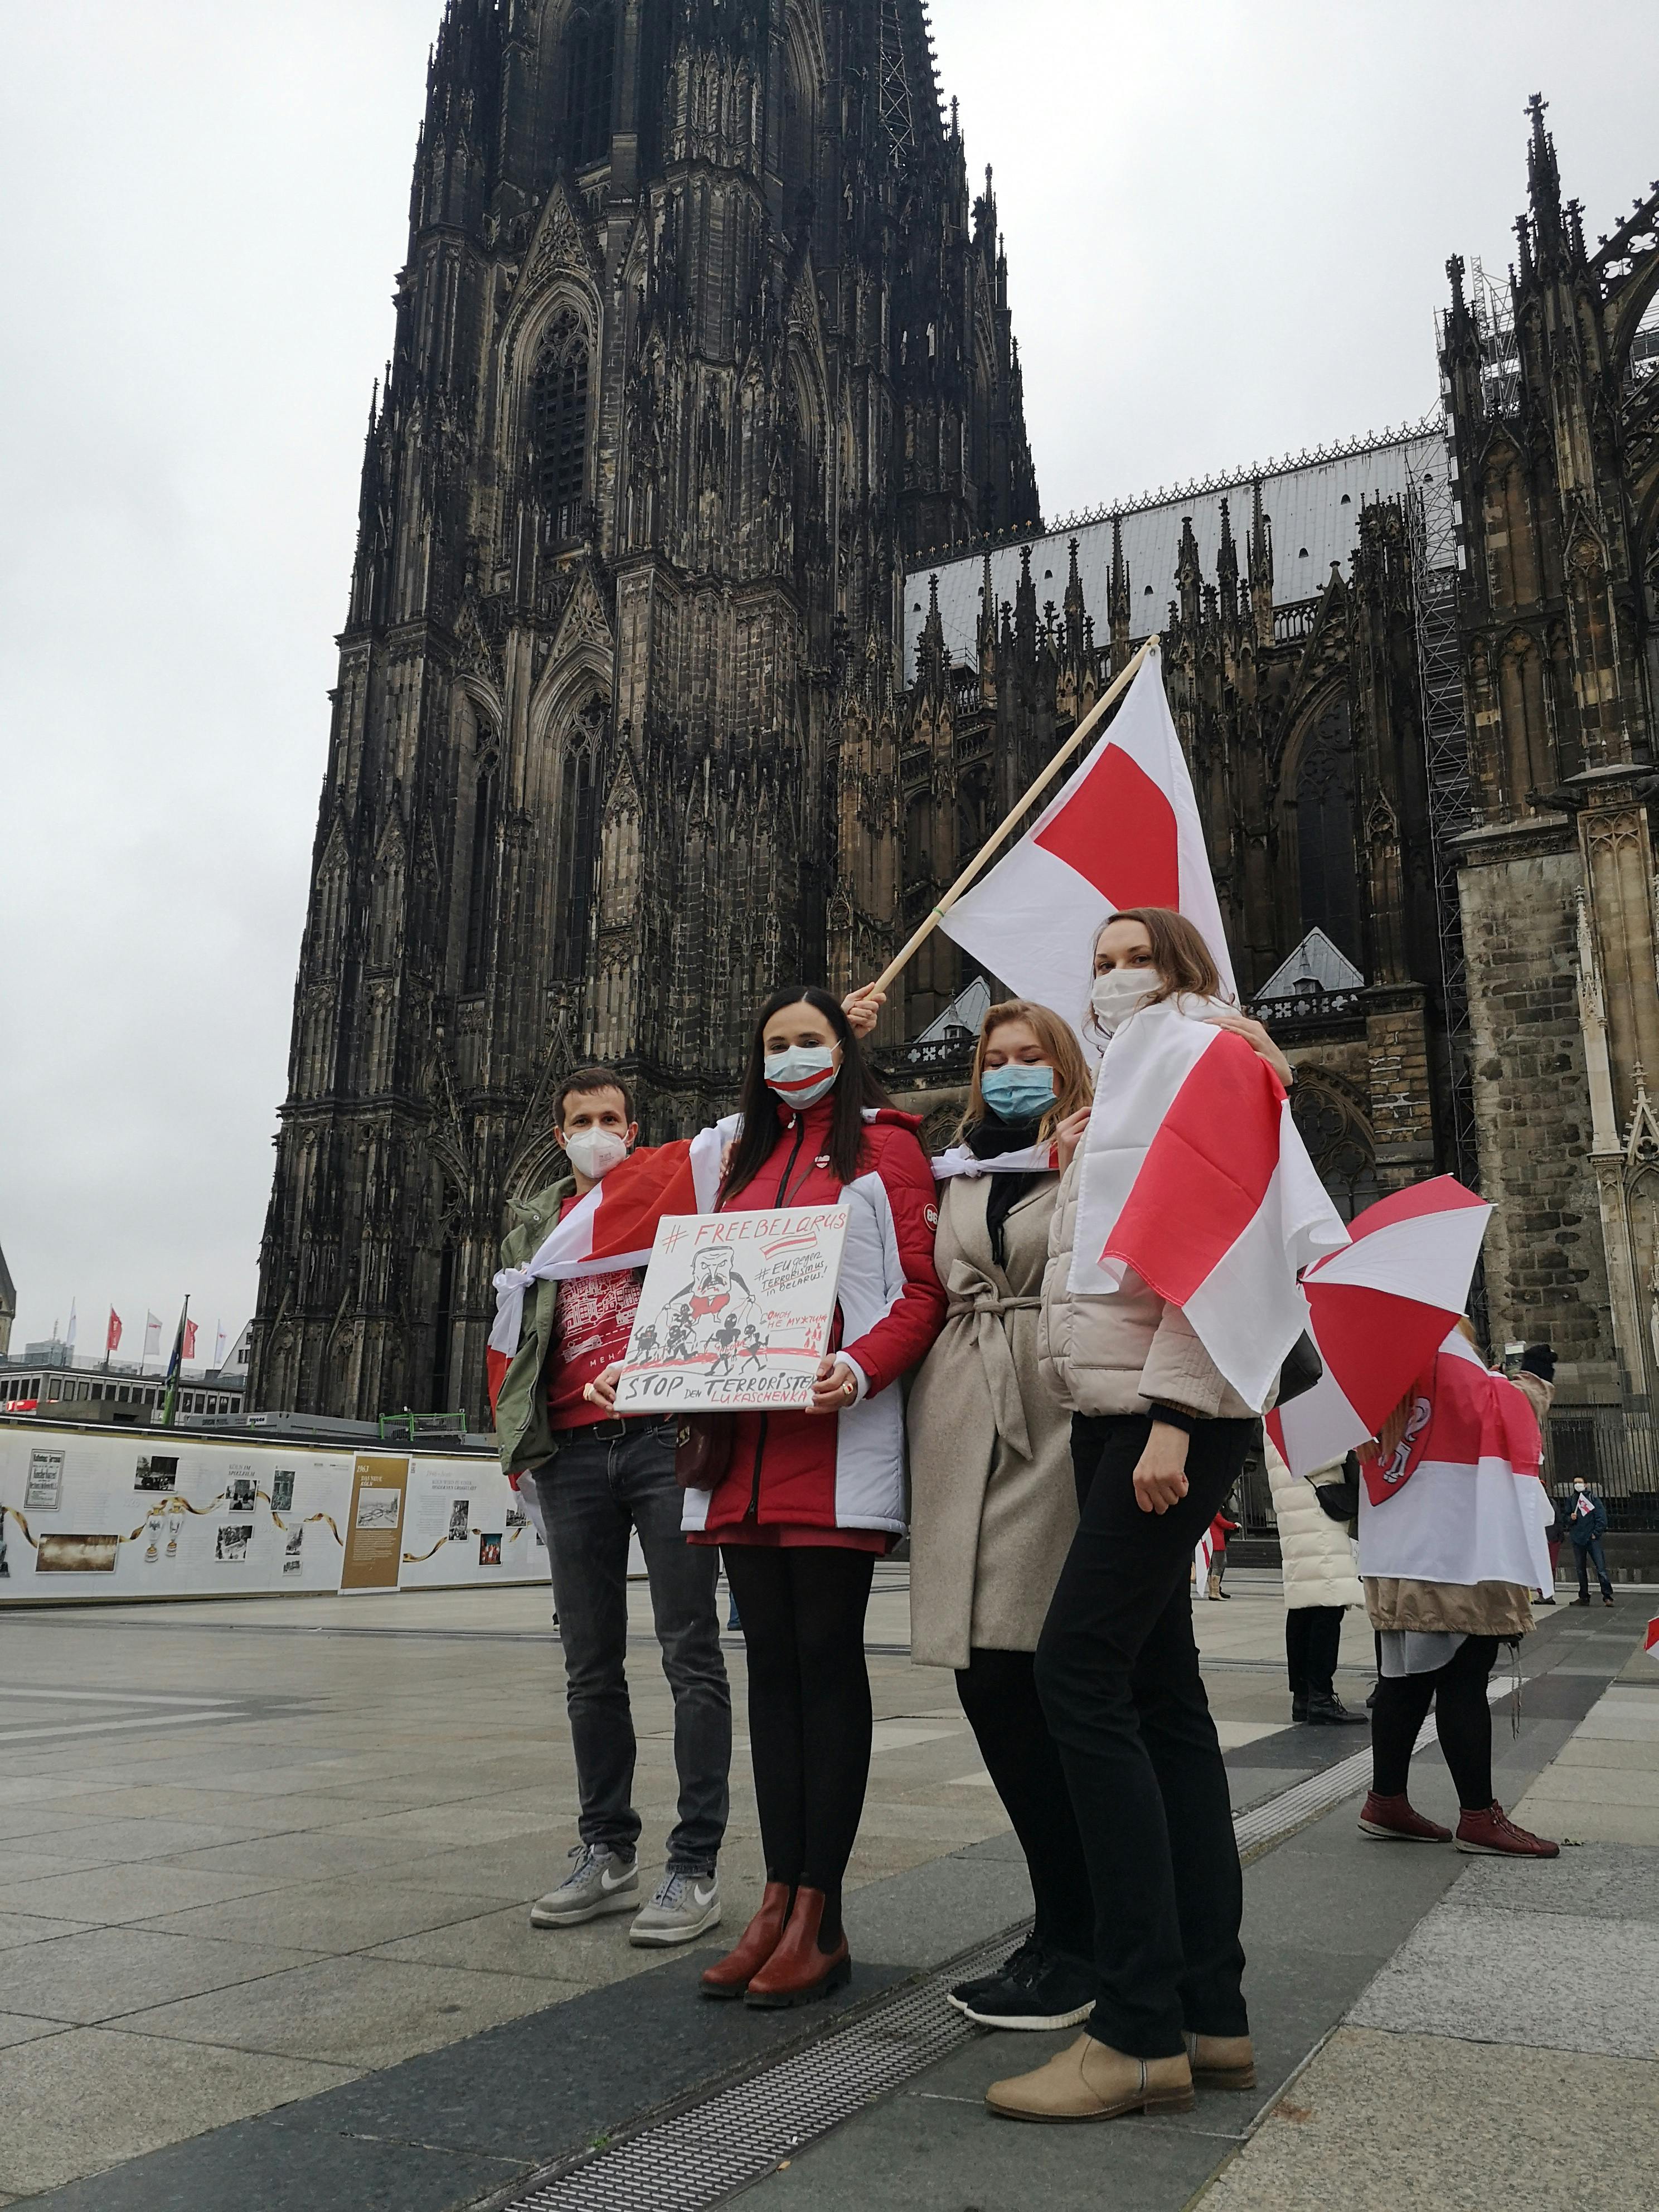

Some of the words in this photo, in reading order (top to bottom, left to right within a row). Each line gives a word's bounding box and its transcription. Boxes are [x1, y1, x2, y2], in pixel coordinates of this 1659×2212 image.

[926, 1209, 938, 1226] 86
[625, 1374, 684, 1400] STOP
[685, 1388, 702, 1399] DEN
[710, 1389, 807, 1404] LUKASCHENKA
